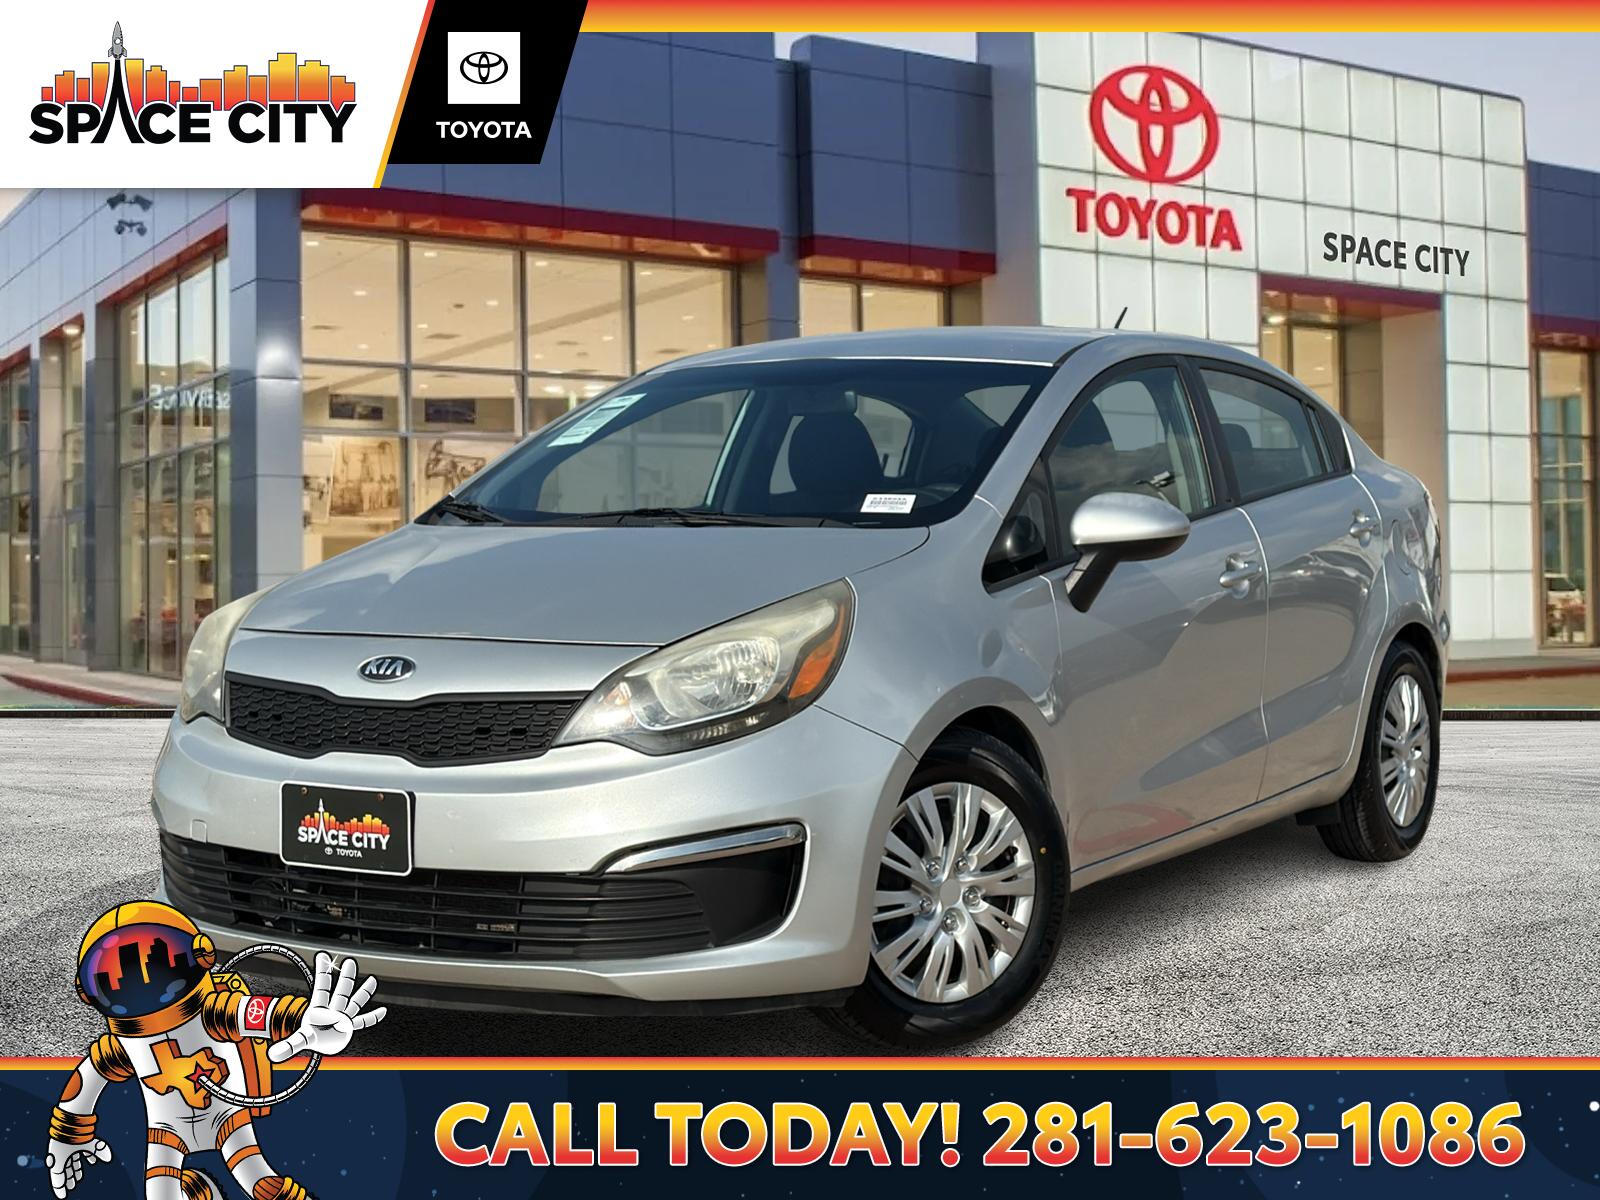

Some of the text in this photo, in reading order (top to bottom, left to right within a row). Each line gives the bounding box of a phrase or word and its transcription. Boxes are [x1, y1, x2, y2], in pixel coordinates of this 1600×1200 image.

[1066, 187, 1243, 252] TOYOTA
[1323, 231, 1471, 277] SPACE CITY
[364, 658, 404, 676] KIA
[351, 831, 391, 850] CITY
[336, 847, 363, 858] TOYOTA
